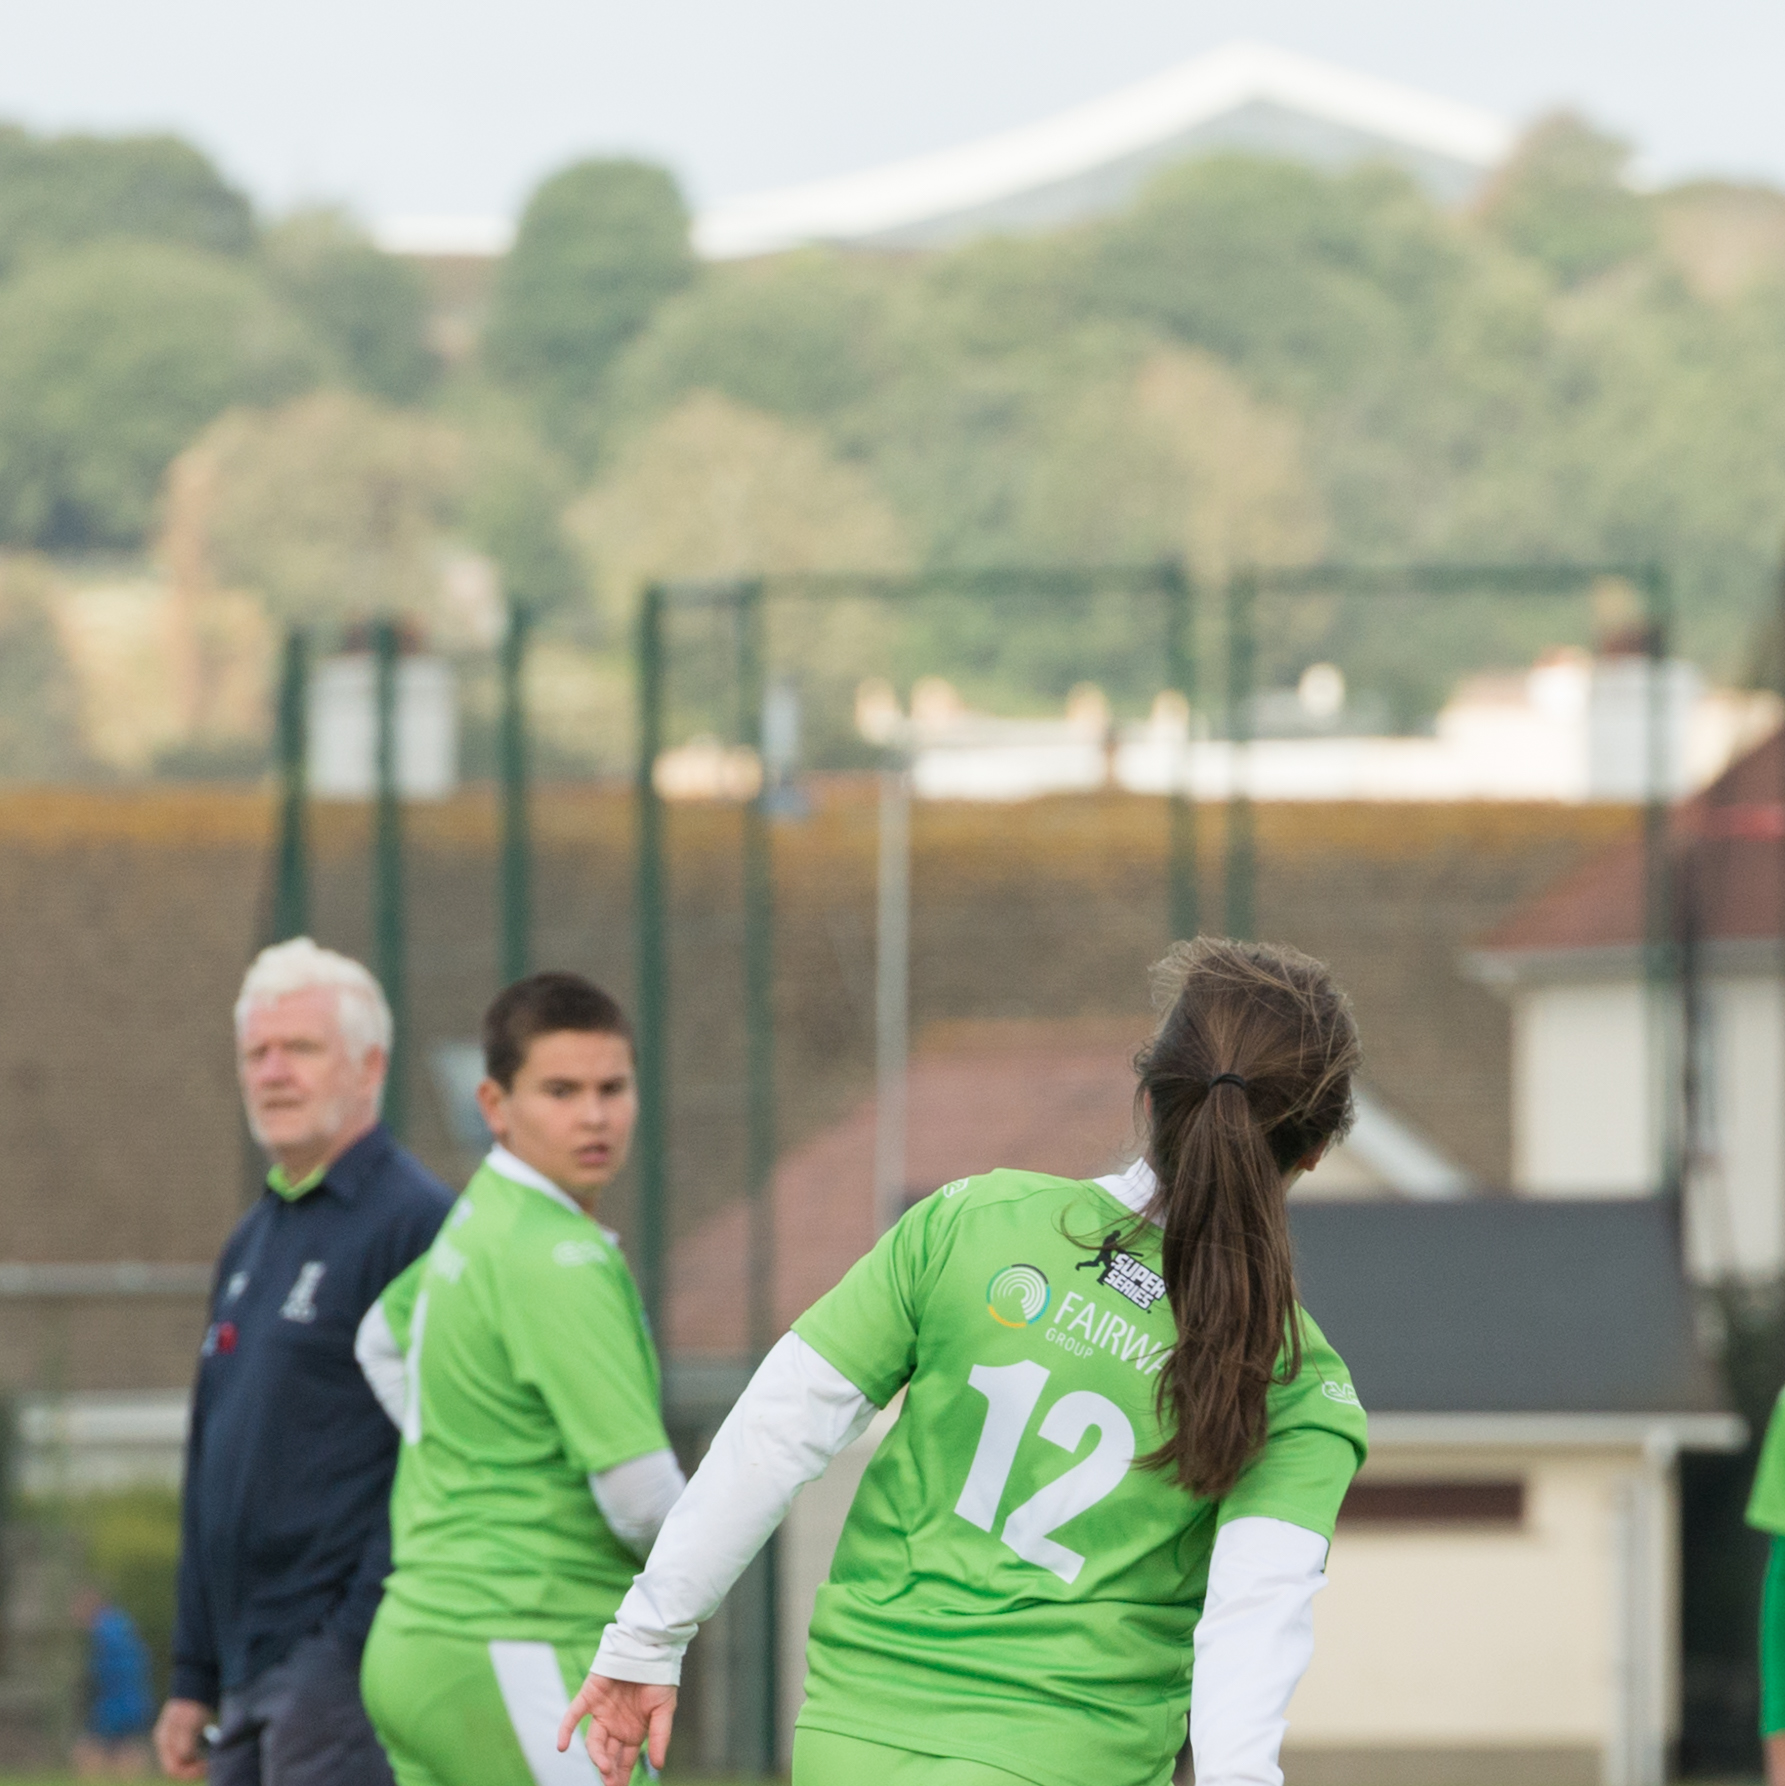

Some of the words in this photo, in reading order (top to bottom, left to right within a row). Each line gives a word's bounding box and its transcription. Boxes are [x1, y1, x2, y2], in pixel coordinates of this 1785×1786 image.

[1104, 1269, 1154, 1310] SERIES
[1110, 1252, 1168, 1300] SUPER
[1045, 1327, 1094, 1360] GROUP
[1054, 1291, 1176, 1376] FAIRWA
[954, 1360, 1136, 1586] 12
